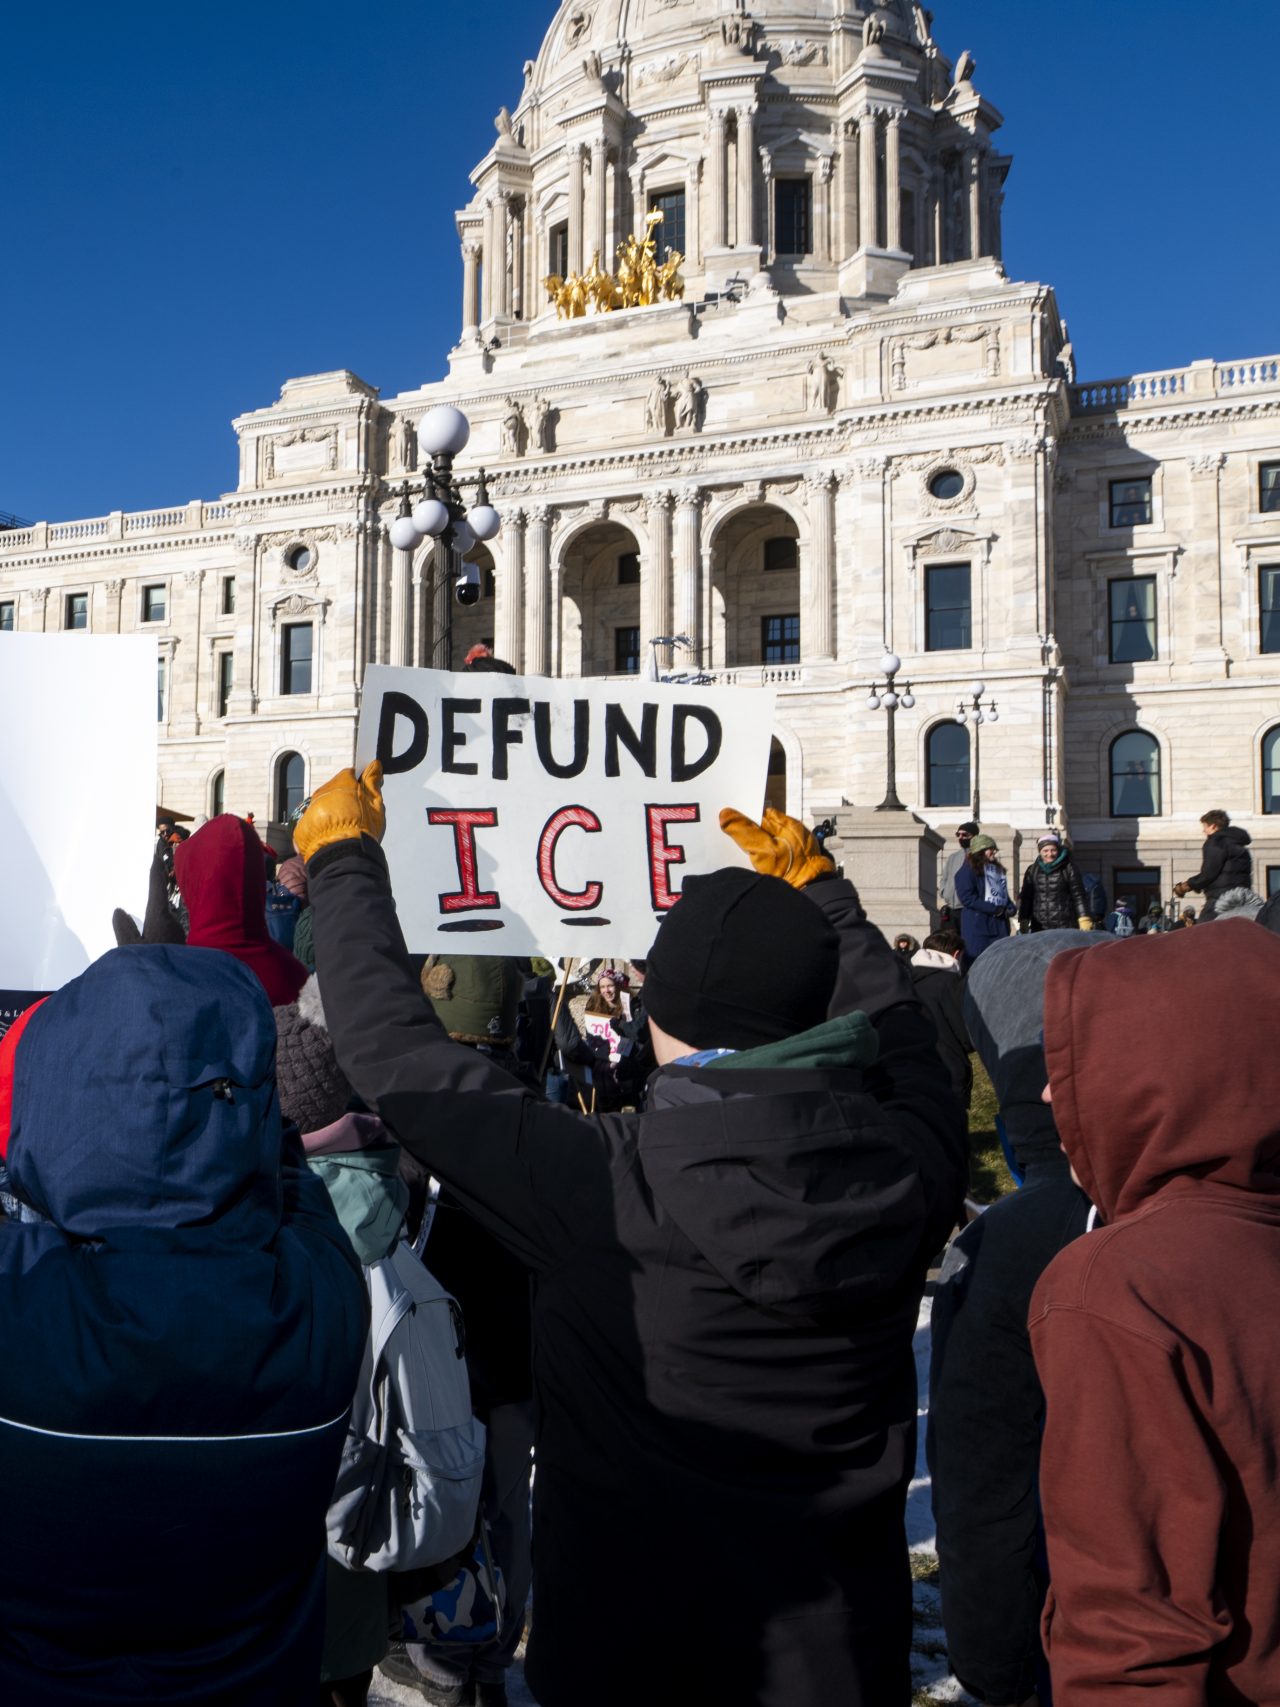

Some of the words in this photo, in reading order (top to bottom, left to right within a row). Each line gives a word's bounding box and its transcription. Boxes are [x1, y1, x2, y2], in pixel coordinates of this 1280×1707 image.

[376, 691, 722, 782] DEFUND
[427, 803, 700, 913] ICE
[4, 1010, 11, 1018] &
